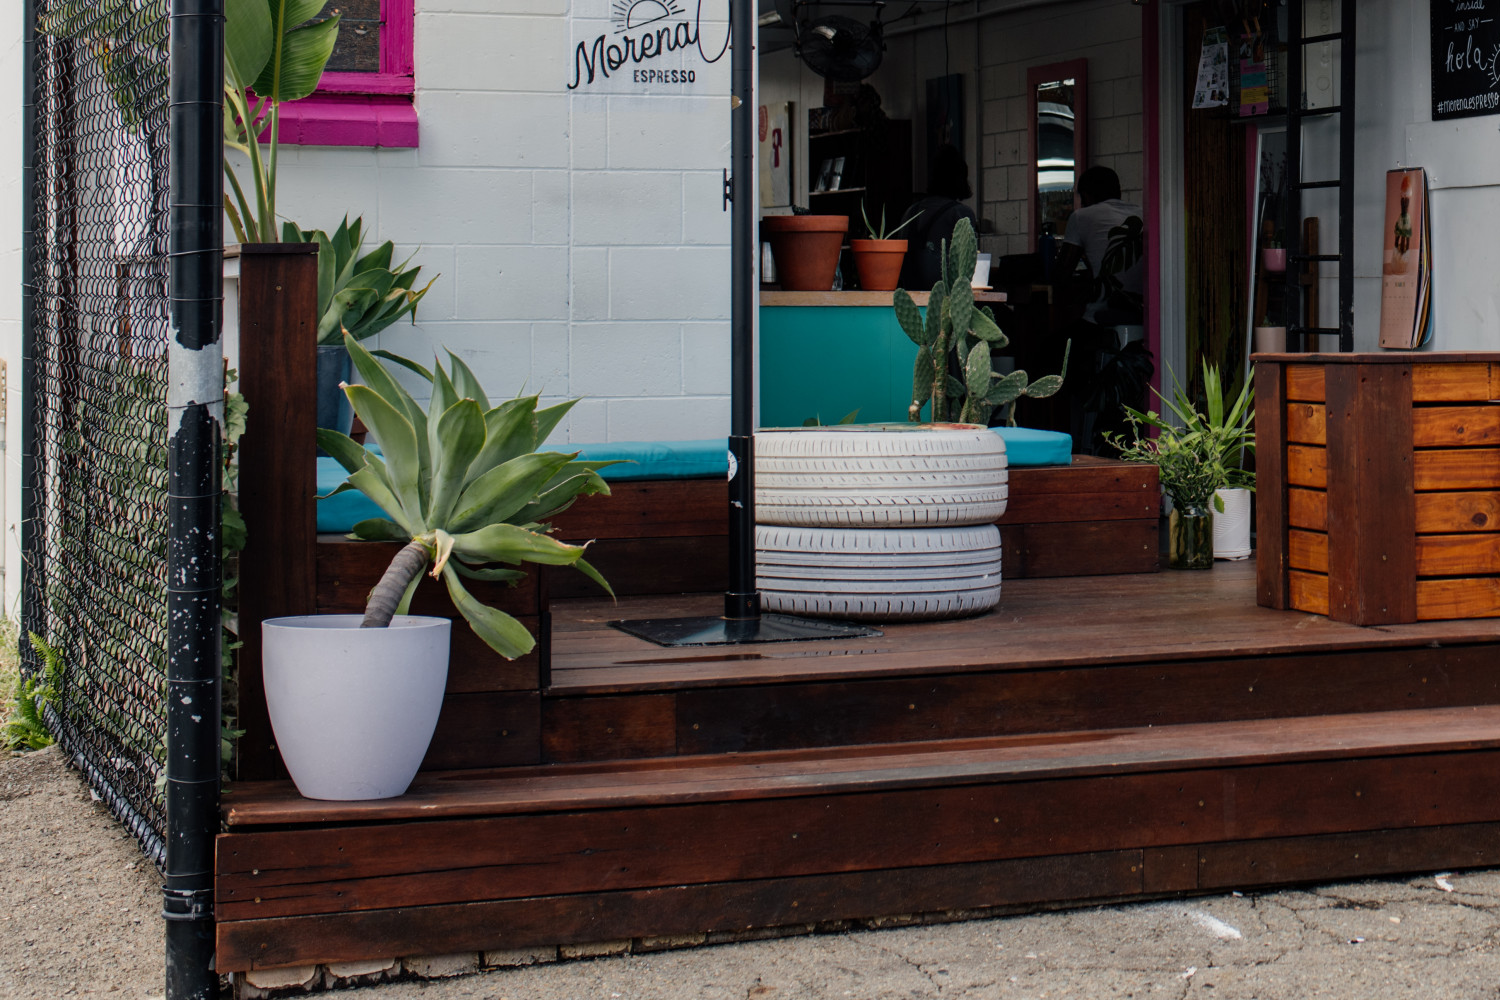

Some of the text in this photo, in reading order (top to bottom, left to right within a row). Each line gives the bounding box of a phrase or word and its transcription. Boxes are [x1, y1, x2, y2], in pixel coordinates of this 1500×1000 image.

[1454, 18, 1480, 32] AND SAY
[567, 22, 699, 89] Morena
[1445, 34, 1488, 73] hola
[633, 69, 696, 84] ESPRESSO
